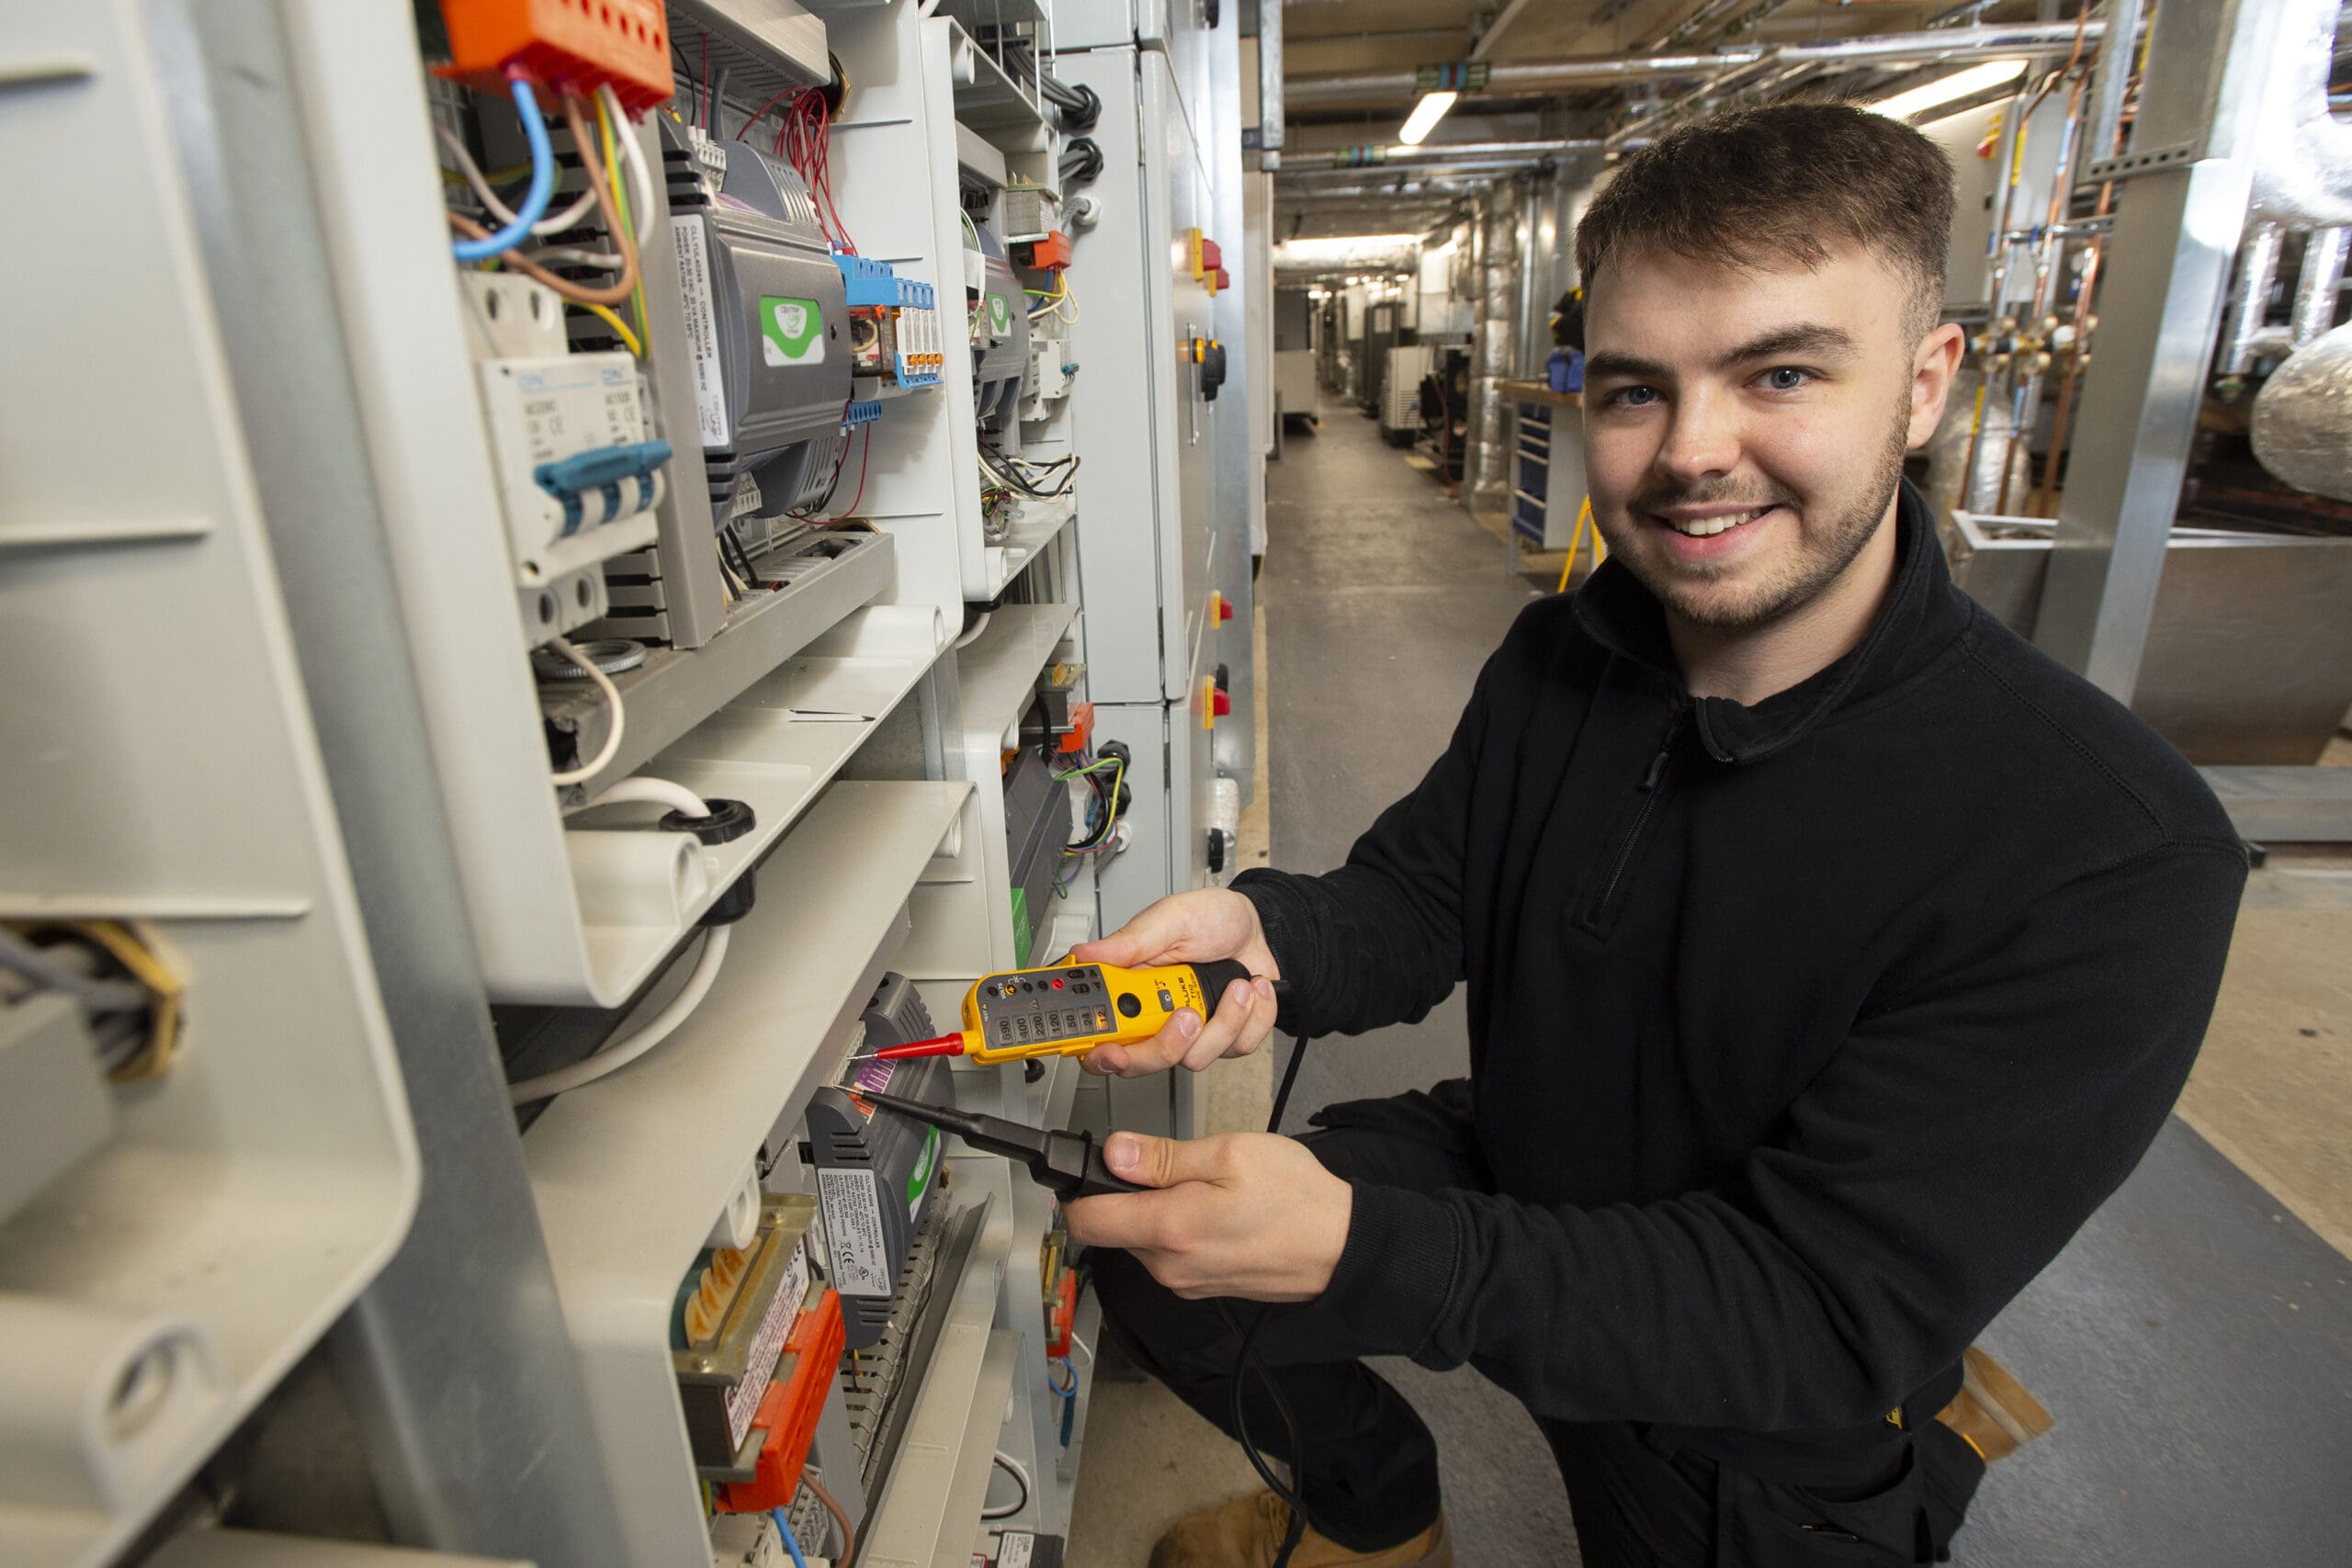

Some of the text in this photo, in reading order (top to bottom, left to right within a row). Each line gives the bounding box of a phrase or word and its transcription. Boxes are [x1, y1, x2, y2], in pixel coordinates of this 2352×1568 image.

[700, 300, 712, 357] CONTROLLER
[998, 982, 1007, 999] VOLTS
[1034, 1015, 1045, 1036] 230
[1049, 1013, 1060, 1032] 120
[1066, 1014, 1077, 1028] 50
[1082, 1012, 1092, 1026] 24
[1097, 1010, 1107, 1023] 12
[1000, 1020, 1012, 1041] 690
[1016, 1018, 1027, 1038] 400
[871, 1216, 879, 1247] CONTROLLER
[842, 1251, 854, 1263] CE
